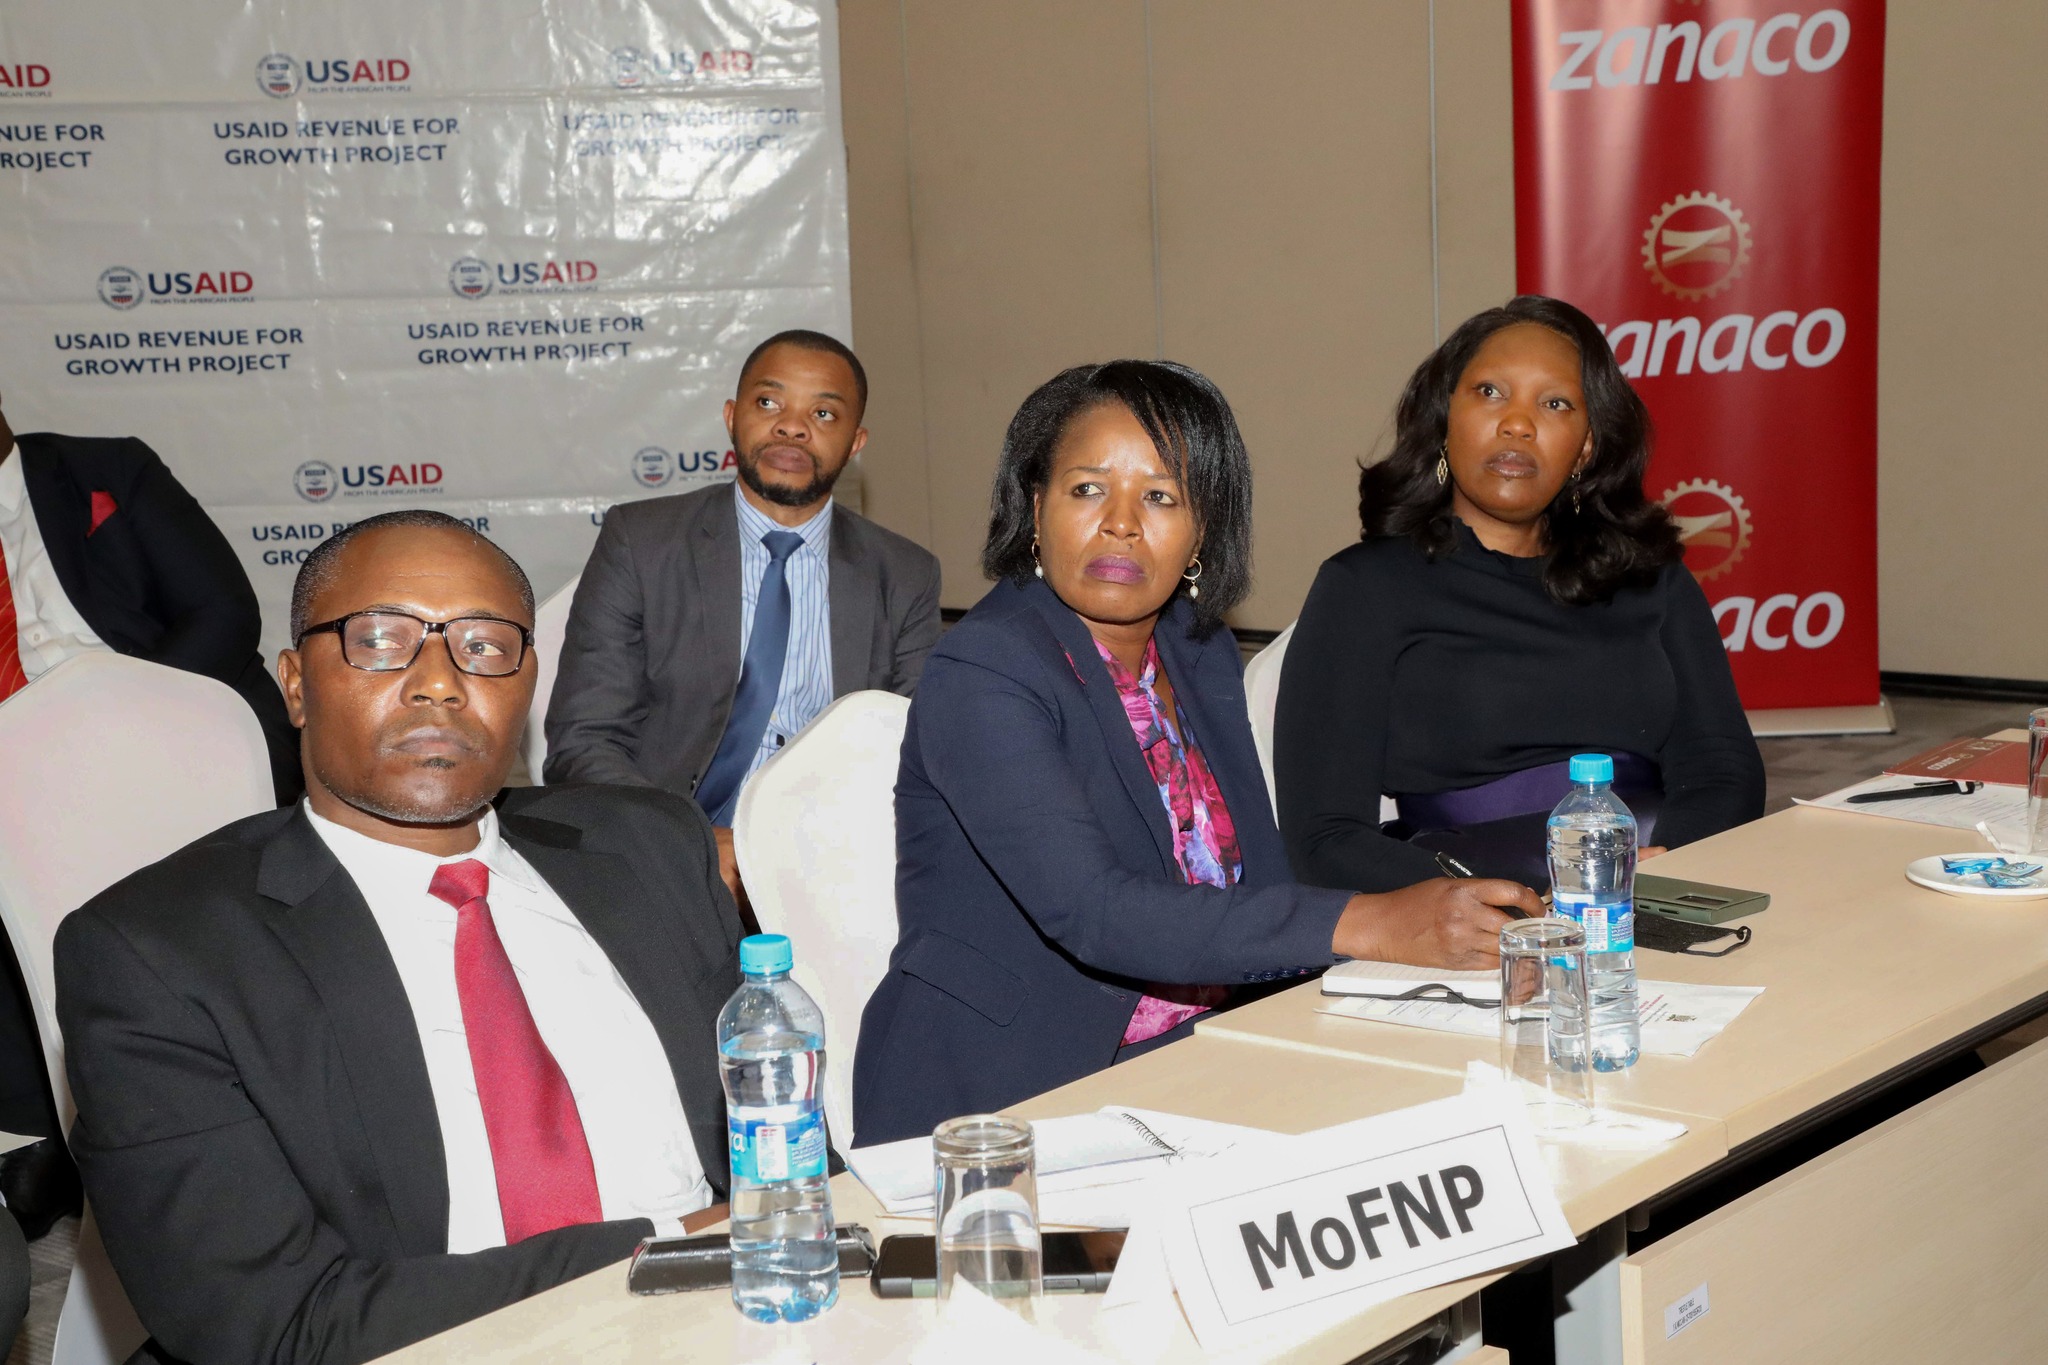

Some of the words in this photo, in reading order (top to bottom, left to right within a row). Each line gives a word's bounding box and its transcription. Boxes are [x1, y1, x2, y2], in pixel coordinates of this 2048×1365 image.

[1549, 9, 1851, 92] zanaco
[305, 59, 411, 83] USAID
[653, 50, 754, 75] USAID
[0, 65, 51, 88] AID
[214, 122, 288, 139] USAID
[296, 119, 406, 137] REVENUE
[413, 118, 460, 134] FOR
[563, 113, 635, 130] USAID
[753, 109, 800, 124] FOR
[55, 124, 105, 141] FOR
[0, 151, 92, 172] ROJECT
[225, 147, 338, 165] GROWTH
[346, 144, 447, 165] PROJECT
[148, 271, 254, 295] USAID
[497, 260, 598, 285] USAID
[55, 333, 130, 350] USAID
[138, 330, 249, 348] REVENUE
[256, 328, 304, 345] FOR
[407, 322, 479, 340] USAID
[487, 318, 592, 337] REVENUE
[600, 316, 645, 332] FOR
[66, 358, 180, 375] GROWTH
[189, 354, 291, 374] PROJECT
[418, 347, 526, 365] GROWTH
[534, 341, 632, 362] PROJECT
[678, 450, 738, 473] USA
[342, 463, 443, 487] USAID
[252, 524, 324, 541] USAID
[1711, 591, 1845, 653] aco
[1239, 1164, 1485, 1291] MoFNP
